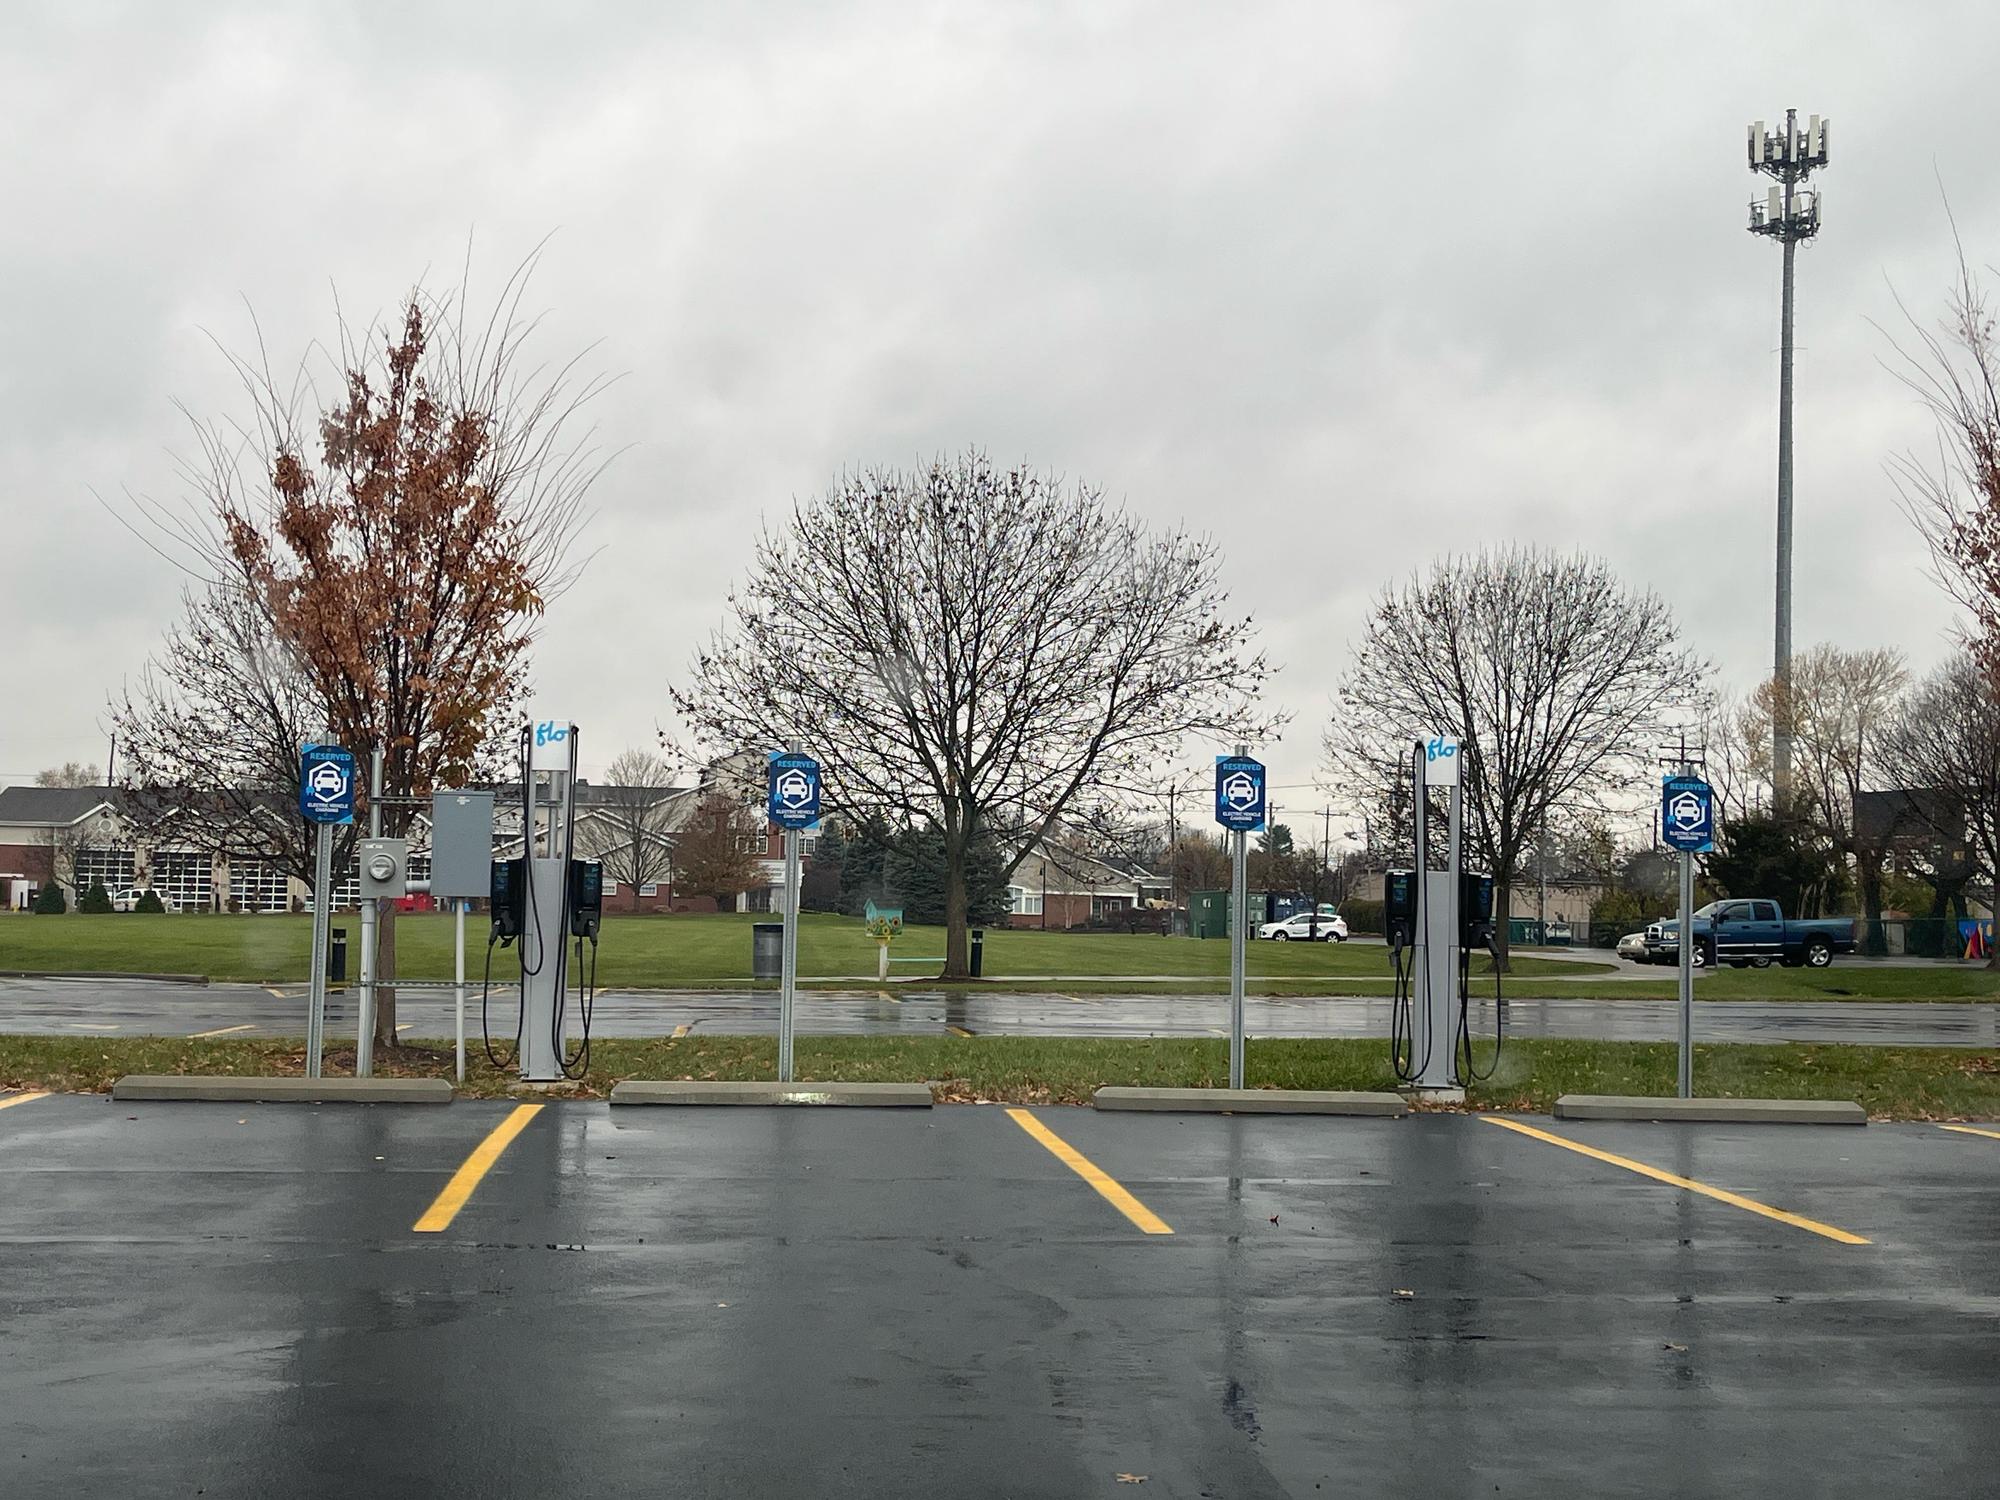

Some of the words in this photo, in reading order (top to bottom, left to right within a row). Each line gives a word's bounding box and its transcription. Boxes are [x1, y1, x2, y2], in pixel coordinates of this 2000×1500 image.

[536, 720, 569, 747] flo
[1427, 735, 1457, 762] flo
[309, 752, 351, 761] RESERVED
[777, 760, 817, 769] RESERVED
[1223, 763, 1262, 771] RESERVED
[1669, 783, 1708, 791] RESERVED
